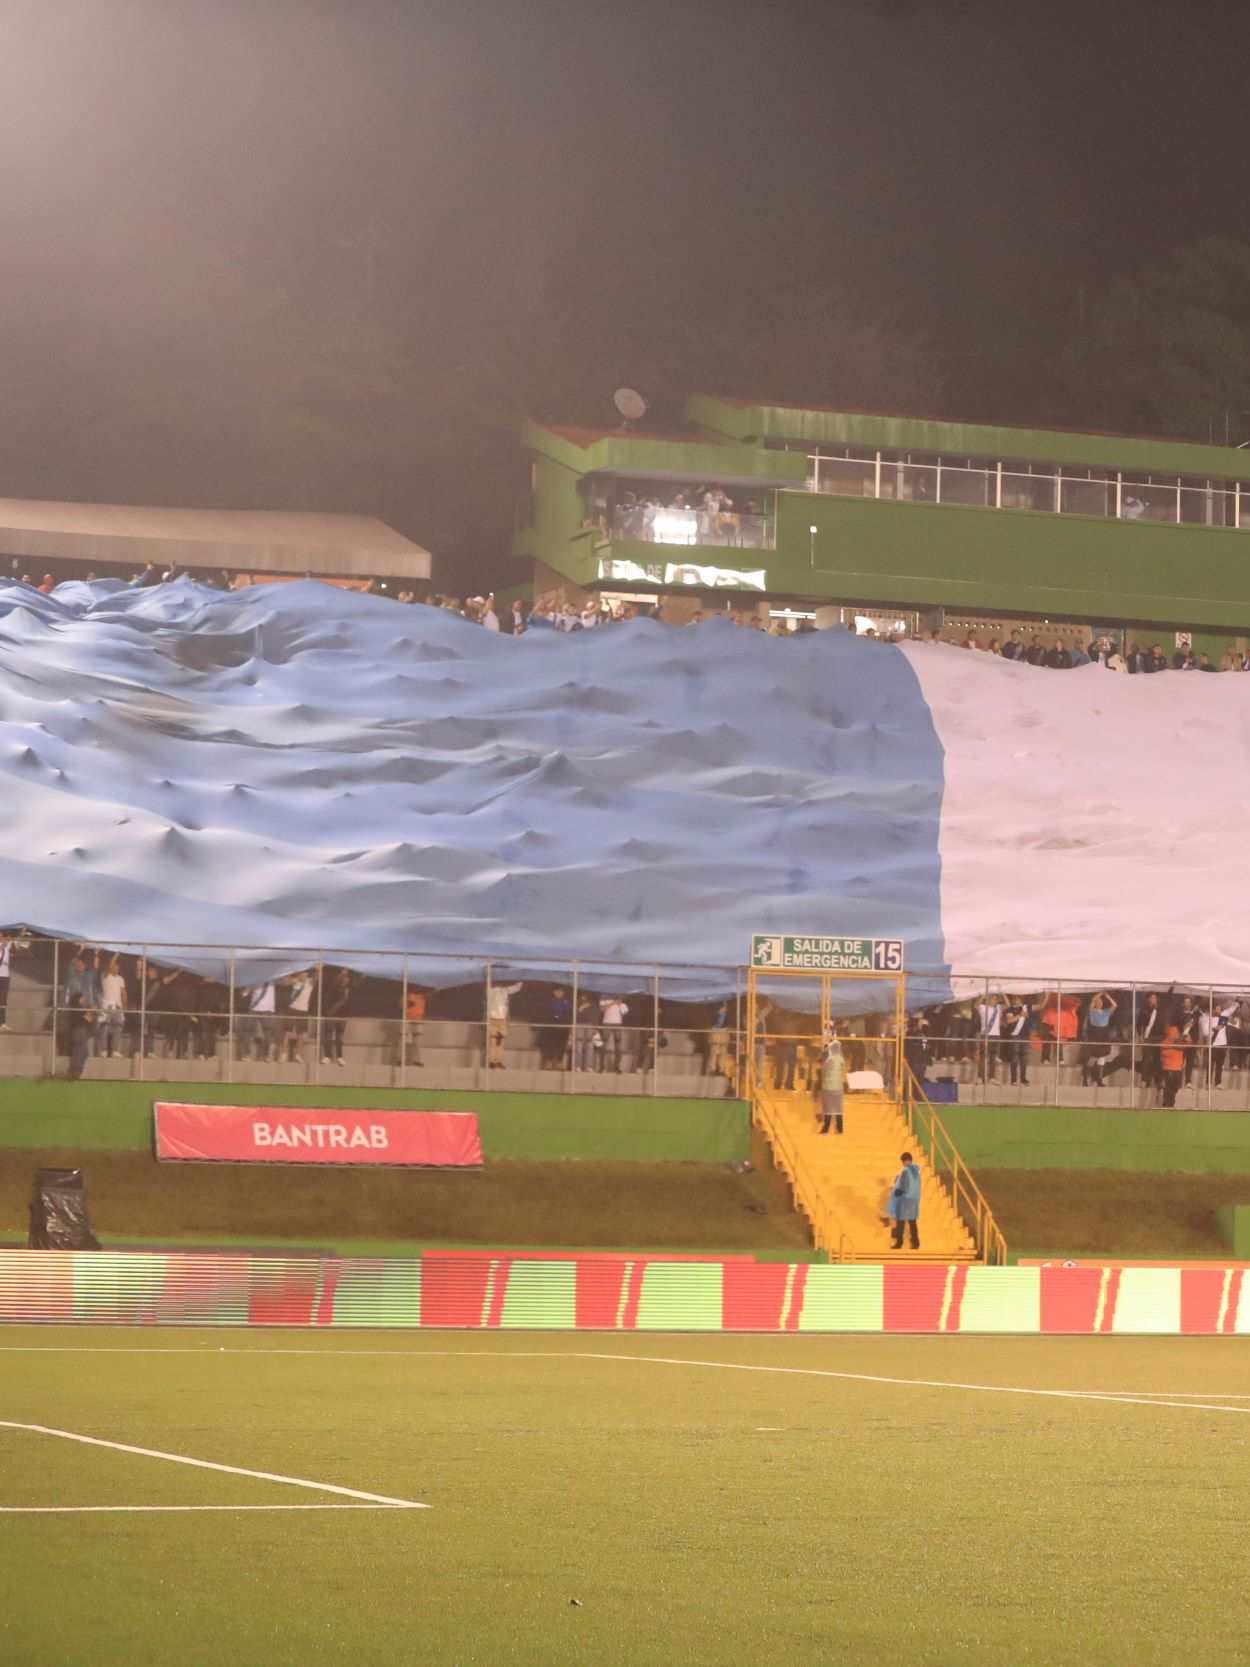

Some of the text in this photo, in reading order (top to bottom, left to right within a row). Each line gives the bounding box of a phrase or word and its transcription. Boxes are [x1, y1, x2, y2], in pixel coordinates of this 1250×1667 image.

[793, 939, 862, 954] SALIDA DE
[875, 942, 900, 969] 15
[784, 953, 871, 969] EMERGENCIA
[252, 1122, 389, 1149] BANTRAB
